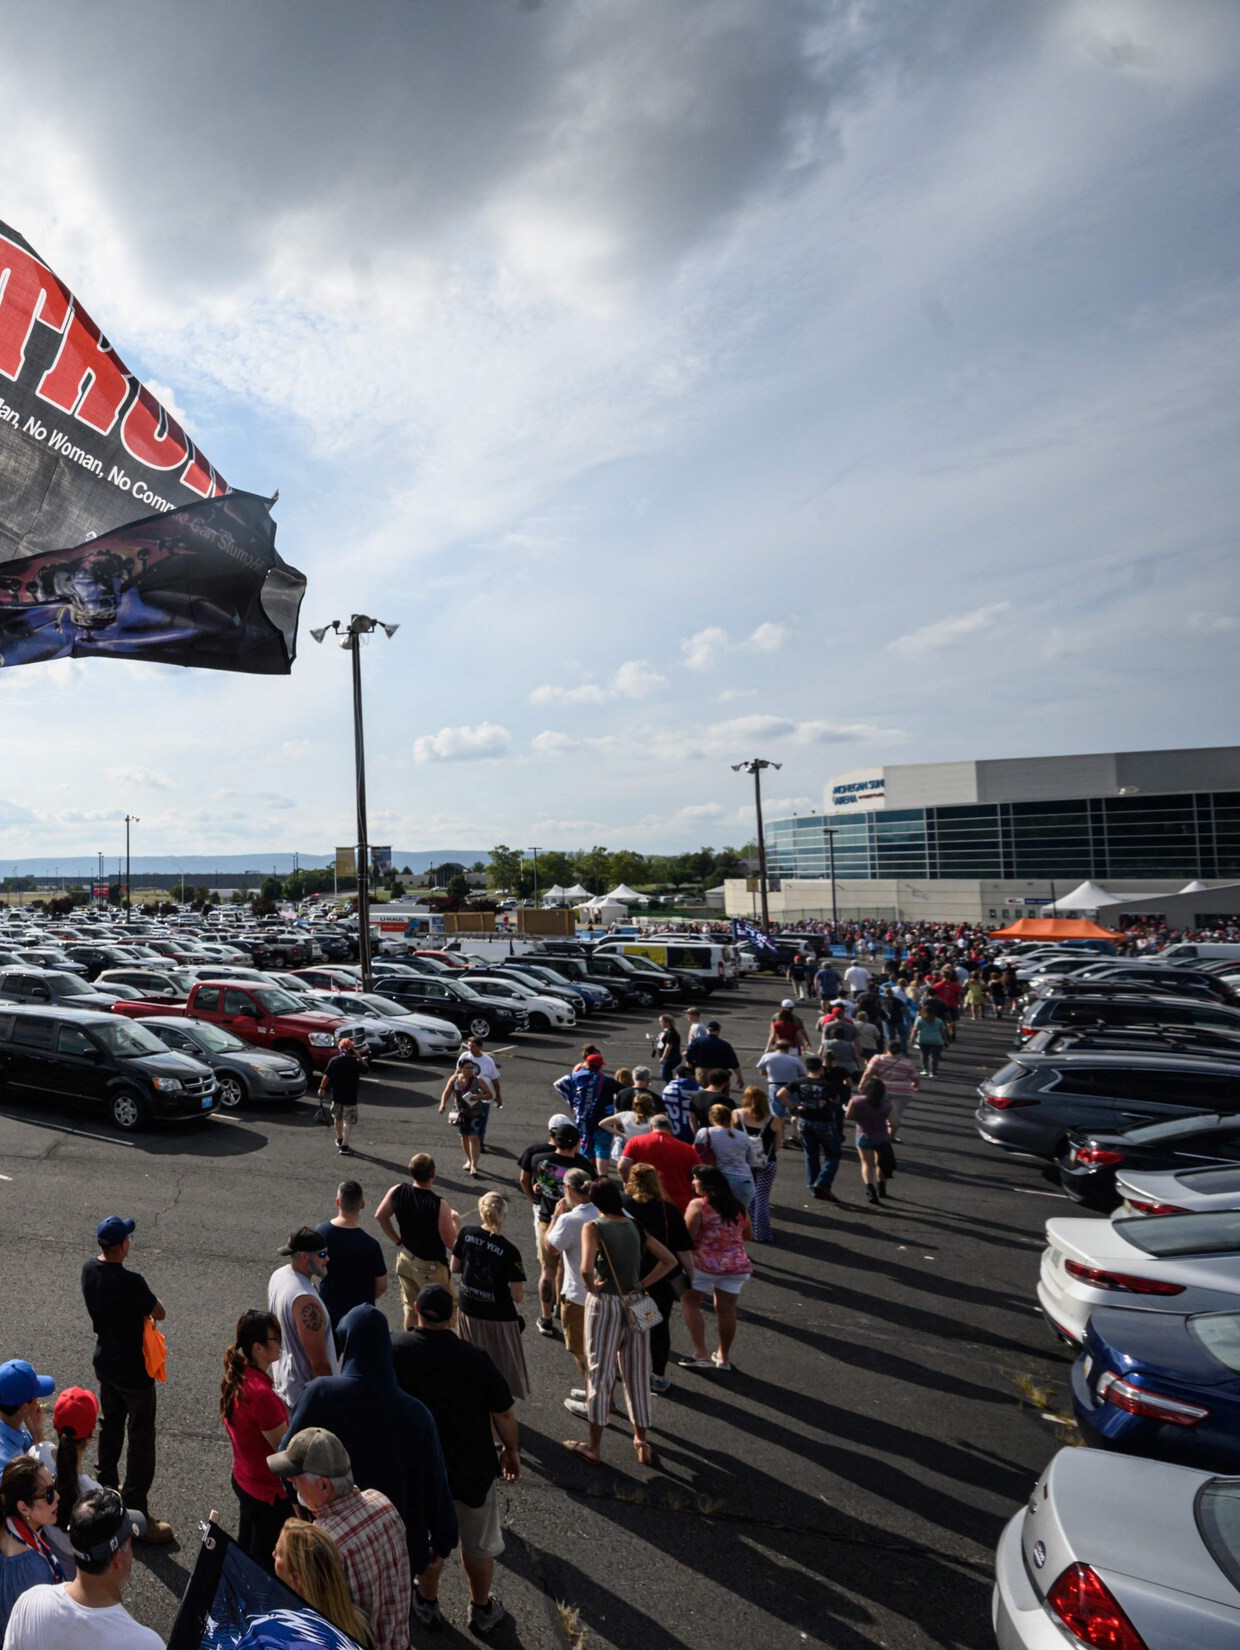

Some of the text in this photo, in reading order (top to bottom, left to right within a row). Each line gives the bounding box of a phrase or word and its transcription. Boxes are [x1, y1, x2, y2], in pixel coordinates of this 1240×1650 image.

[23, 416, 48, 441] No
[48, 427, 105, 478] Woman,
[108, 465, 131, 491] No
[868, 779, 885, 789] SUN
[464, 1234, 504, 1256] ONLY YOU
